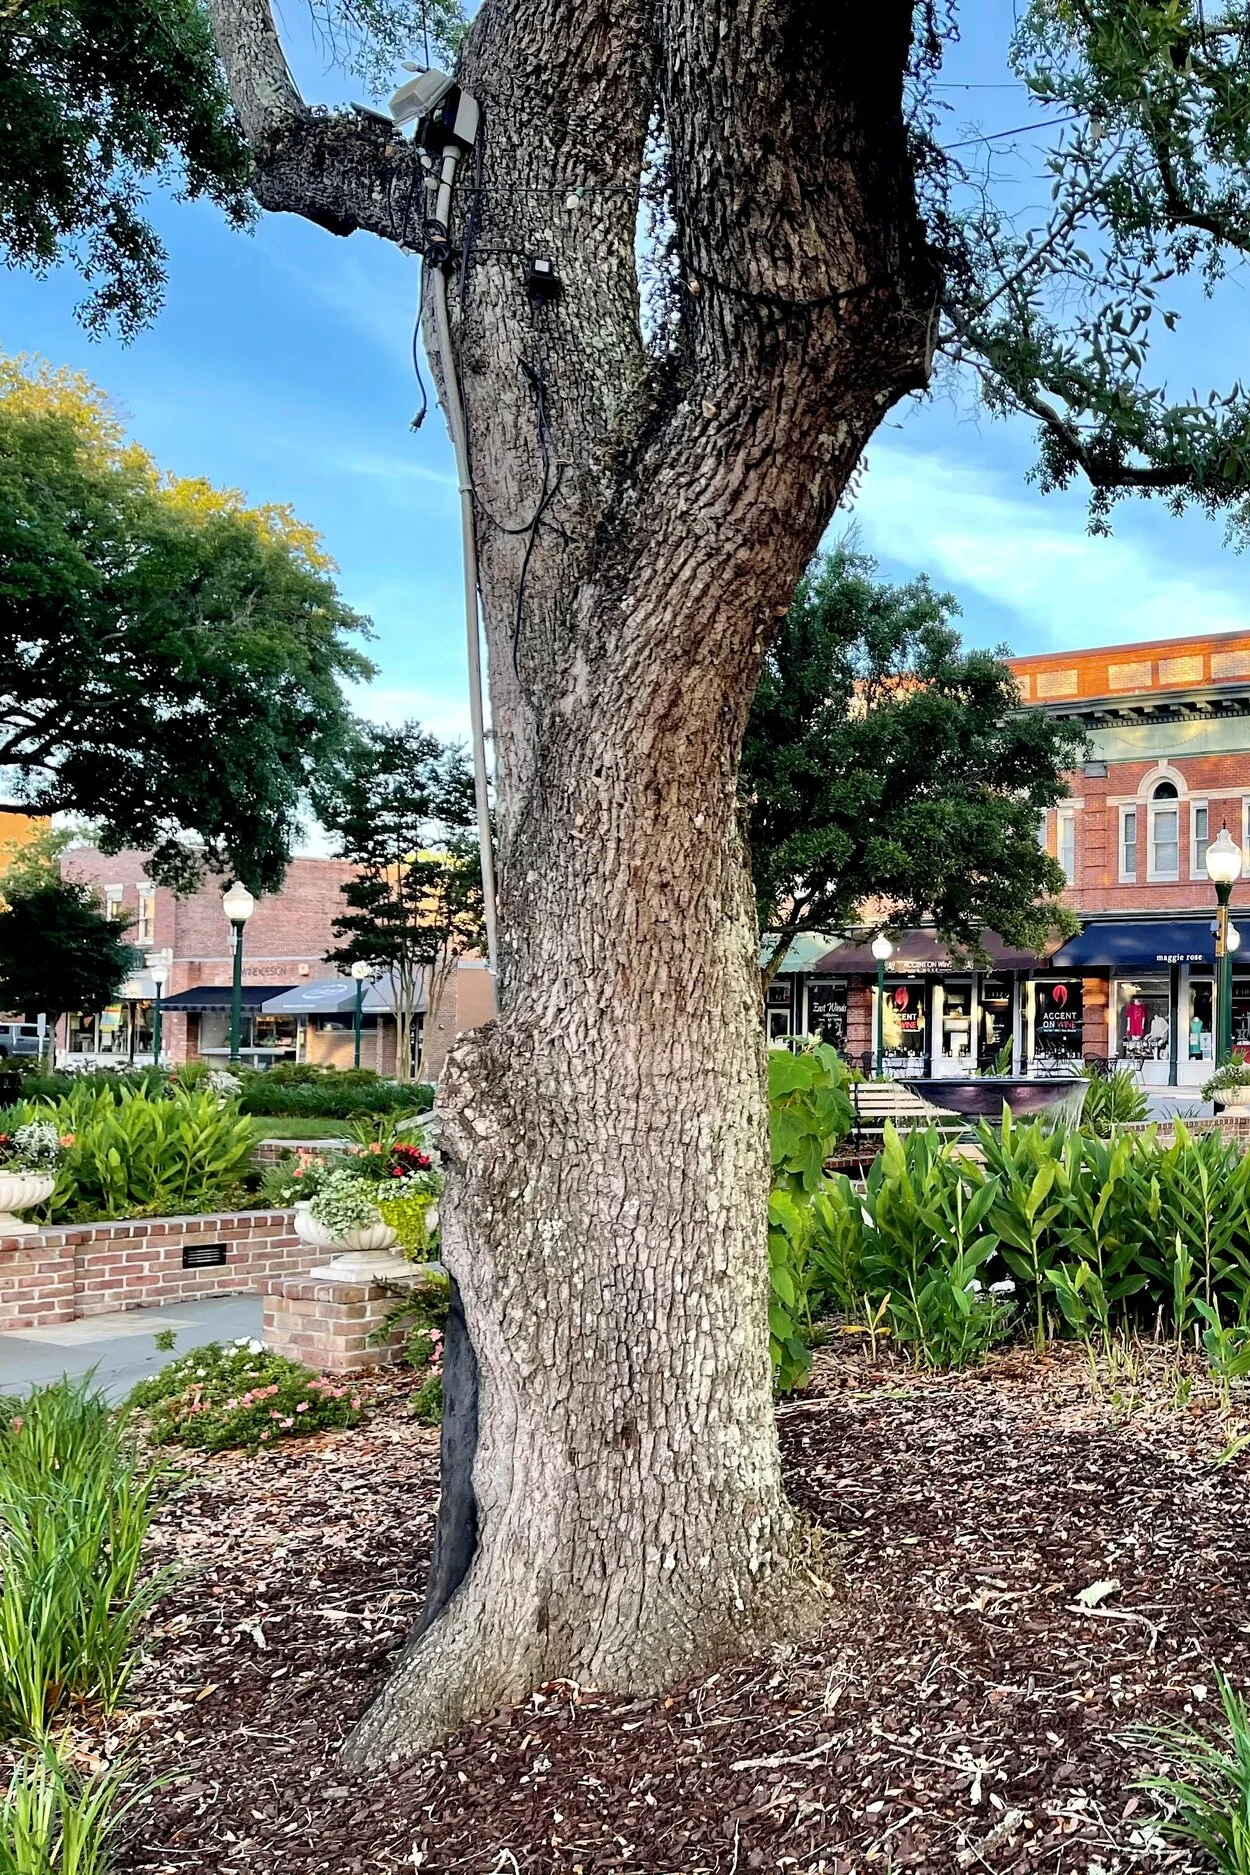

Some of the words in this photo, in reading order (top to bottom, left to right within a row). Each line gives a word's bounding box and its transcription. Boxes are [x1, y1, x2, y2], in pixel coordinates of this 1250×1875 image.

[1156, 954, 1184, 963] maggie
[813, 1002, 826, 1012] East
[827, 1001, 847, 1012] Winds
[1043, 1012, 1077, 1020] ACCENT
[1043, 1020, 1055, 1028] ON
[1057, 1021, 1076, 1029] WINE
